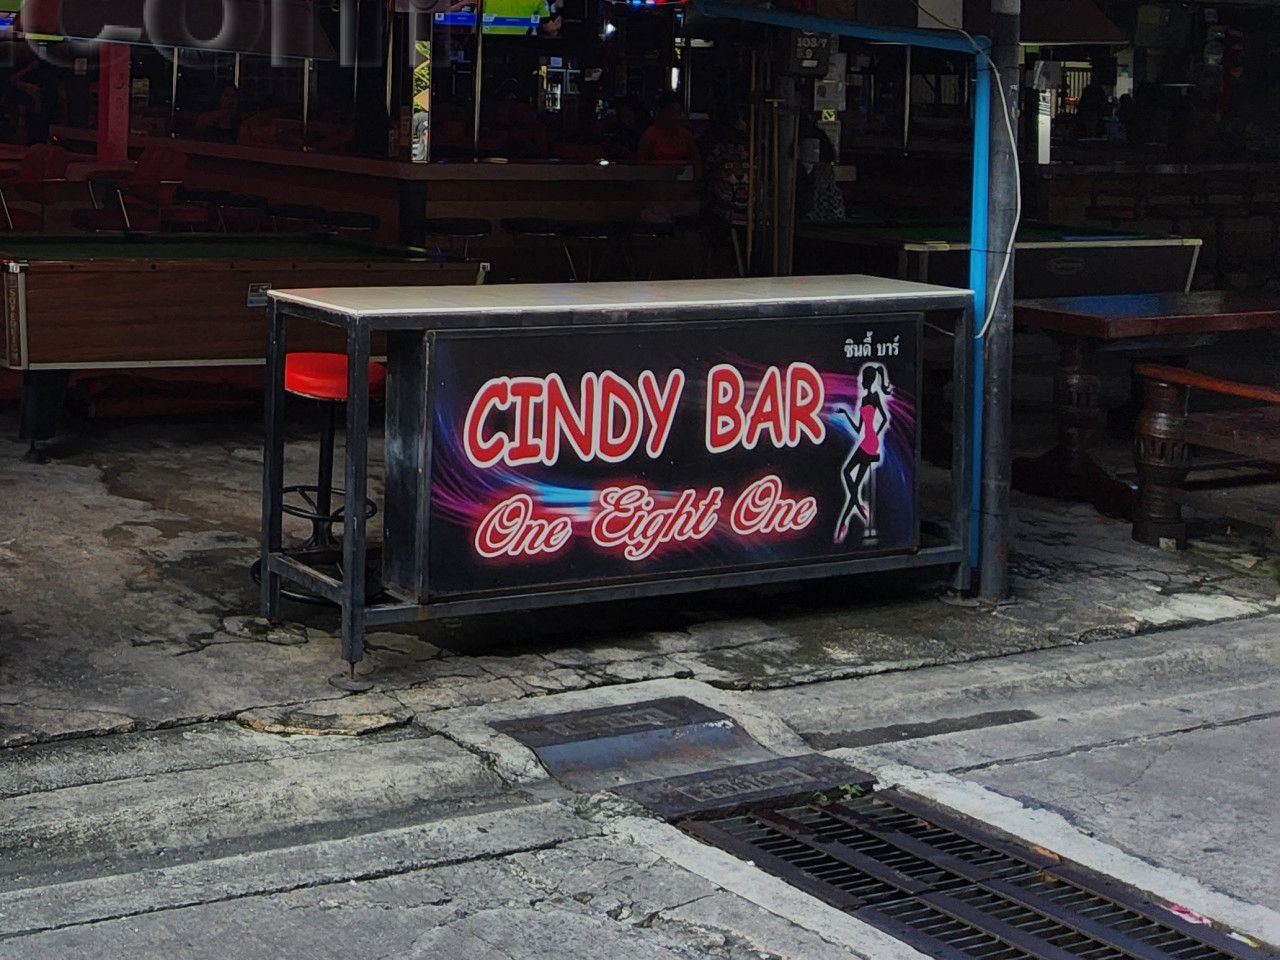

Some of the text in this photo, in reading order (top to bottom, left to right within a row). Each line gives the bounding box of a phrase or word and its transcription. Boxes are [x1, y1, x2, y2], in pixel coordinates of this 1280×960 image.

[844, 330, 900, 358] ซินดี้ บาร์
[464, 362, 826, 469] CINDY BAR
[475, 474, 817, 561] One Eight One
